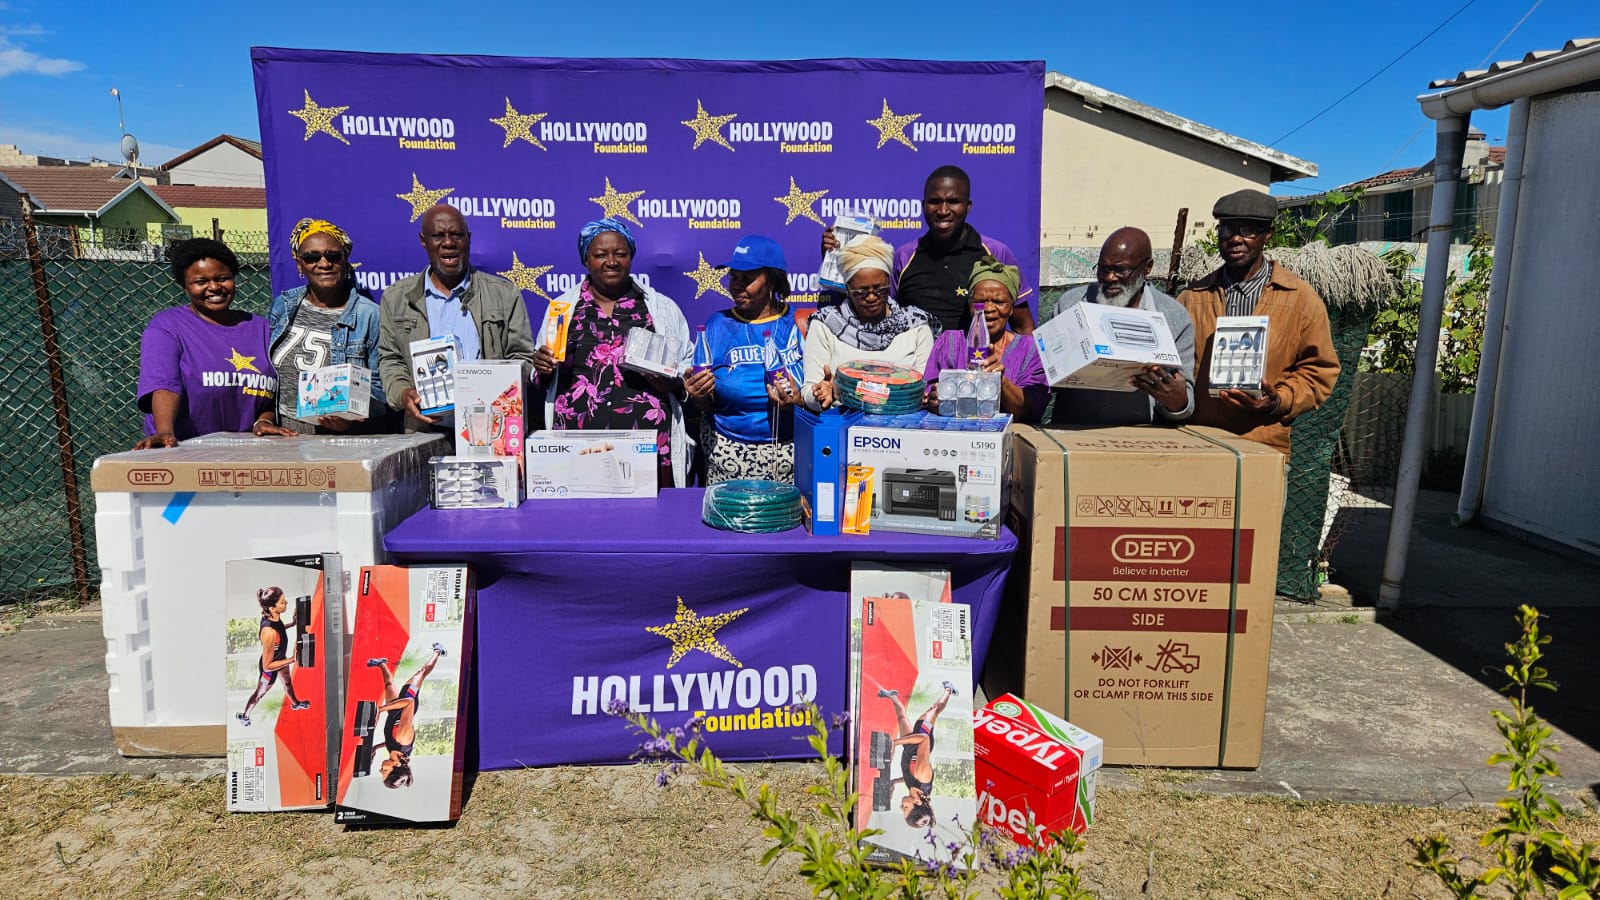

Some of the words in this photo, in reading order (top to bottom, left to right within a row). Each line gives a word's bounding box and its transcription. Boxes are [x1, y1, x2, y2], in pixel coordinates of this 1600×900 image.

[342, 114, 454, 138] HOLLYWOOD
[540, 121, 647, 142] HOLLYWOOD
[730, 121, 832, 142] HOLLYWOOD
[913, 122, 1015, 142] HOLLYWOOD
[400, 137, 456, 150] Foundation
[594, 142, 648, 154] Foundation
[780, 142, 832, 153] Foundation
[962, 143, 1015, 154] Foundation
[448, 197, 555, 217] HOLLYWOOD
[638, 198, 741, 218] HOLLYWOOD
[822, 198, 922, 218] HOLLYWOOD
[501, 218, 556, 228] Foundation
[688, 218, 741, 229] Foundation
[872, 218, 922, 229] undation
[272, 326, 332, 370] 75
[730, 348, 760, 364] BLUE
[854, 436, 900, 449] EPSON
[134, 472, 166, 482] DEFY
[1125, 542, 1184, 557] DEFY
[1113, 566, 1147, 576] Believe
[1150, 566, 1158, 575] in
[1161, 567, 1189, 576] better
[1093, 588, 1113, 601] 50
[1118, 588, 1147, 601] CM
[1154, 588, 1208, 602] STOVE
[1132, 614, 1165, 626] SIDE
[572, 664, 817, 715] HOLLYWOOD
[1098, 678, 1115, 687] DO
[1118, 679, 1140, 688] NOT
[1144, 679, 1190, 689] FORKLIFT
[1074, 690, 1090, 699] OR
[1092, 690, 1130, 699] CLAMP
[1133, 691, 1163, 700] FROM
[1167, 692, 1187, 701] THIS
[1191, 692, 1213, 701] SIDE
[974, 710, 1065, 770] Typek
[337, 812, 343, 820] 2
